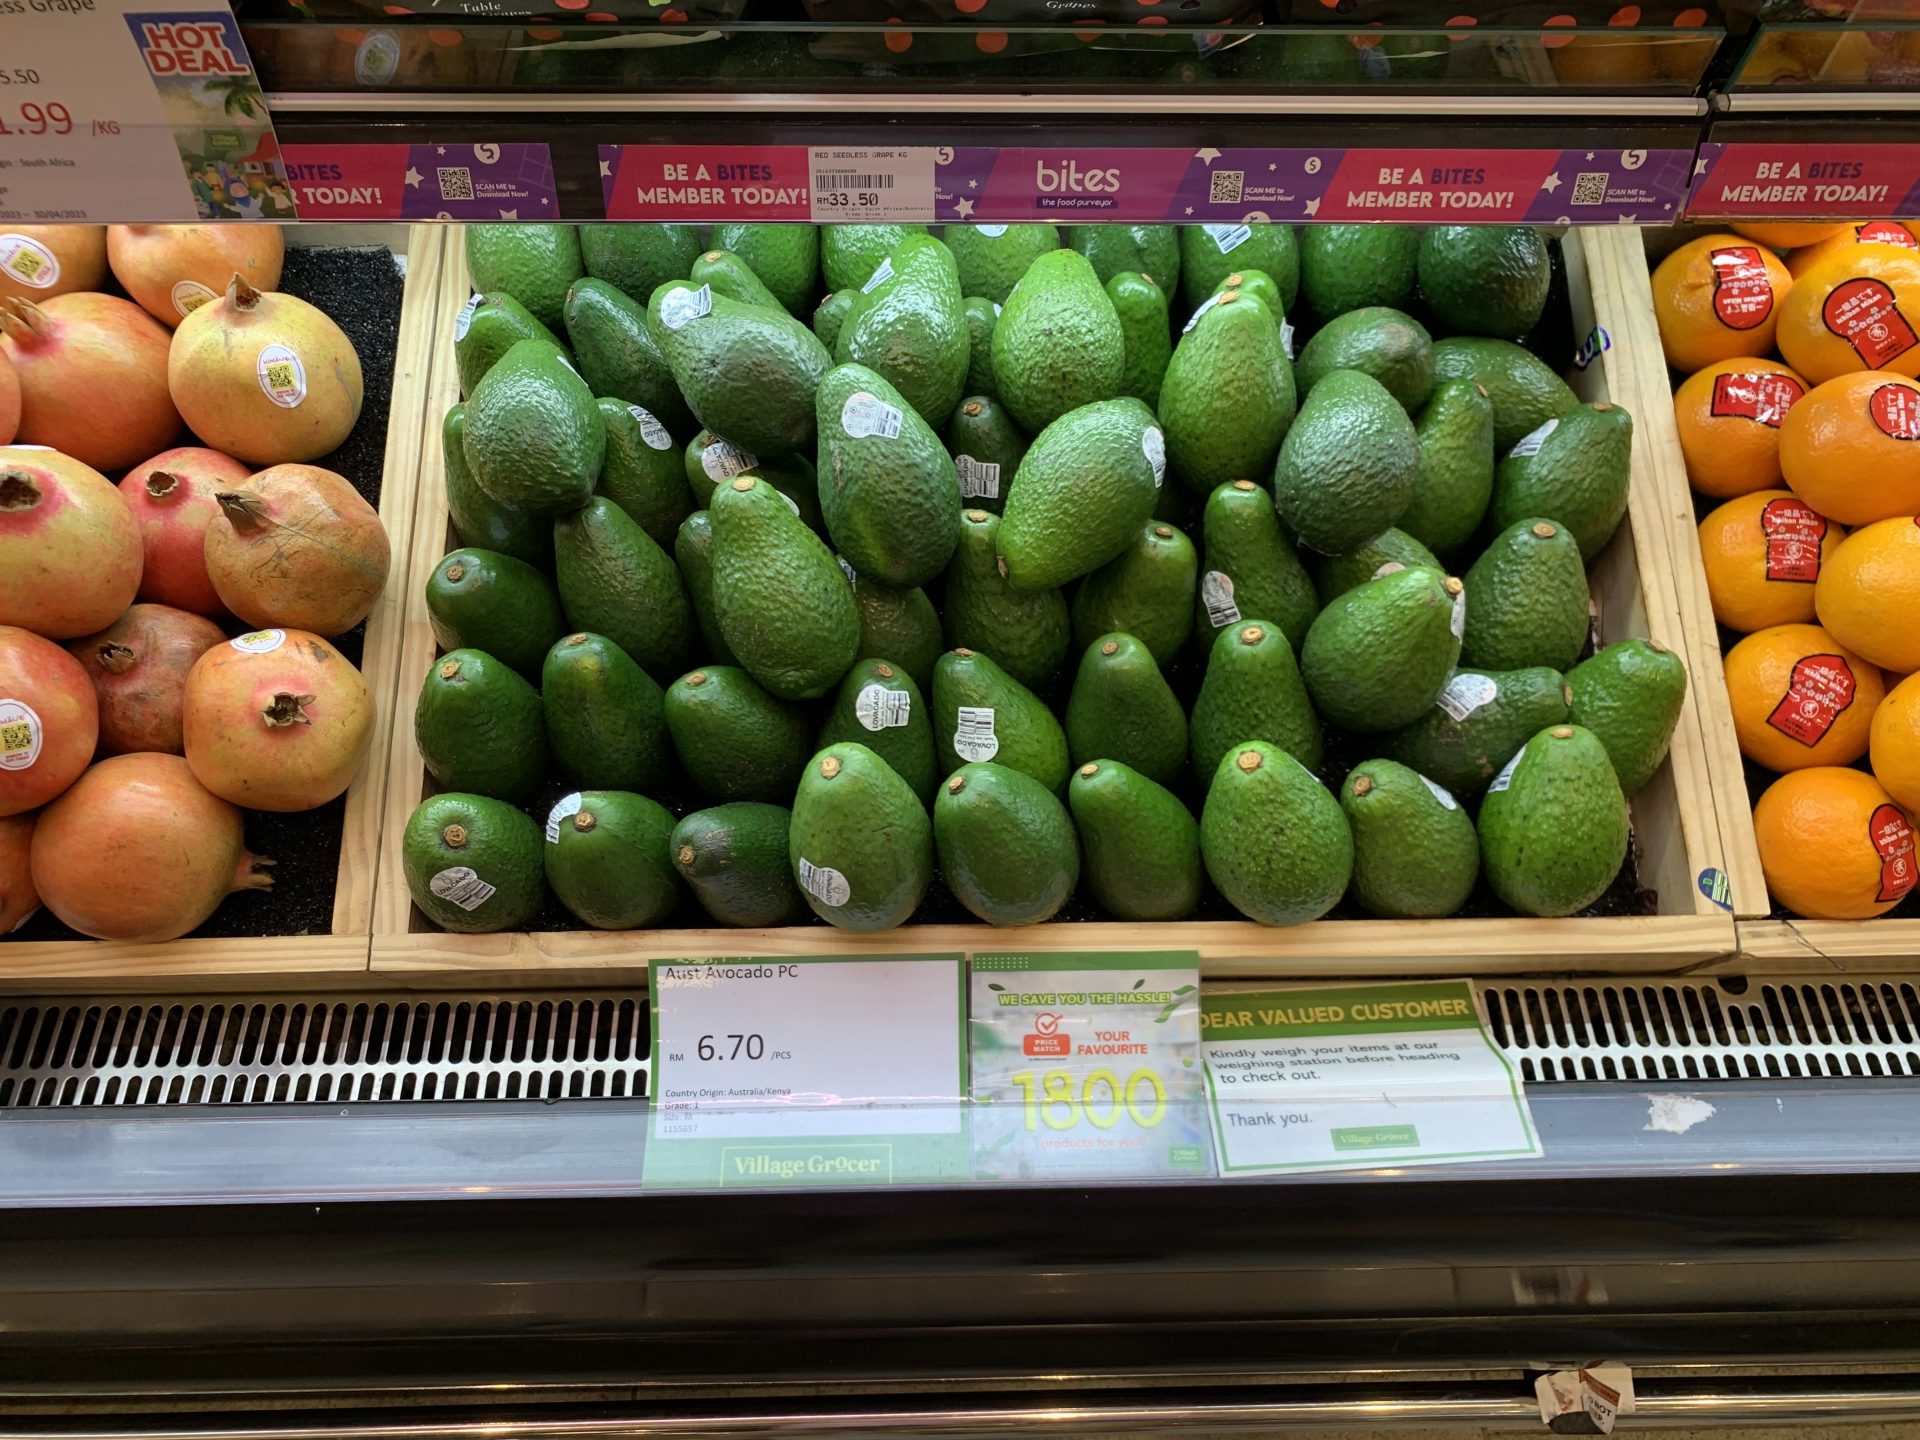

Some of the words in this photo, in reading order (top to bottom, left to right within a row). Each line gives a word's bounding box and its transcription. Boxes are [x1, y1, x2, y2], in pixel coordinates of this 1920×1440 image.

[28, 0, 96, 14] Grape
[460, 2, 501, 13] Table
[1046, 1, 1098, 9] Grapes
[145, 25, 223, 49] HOT
[147, 50, 247, 73] DEAL
[0, 68, 40, 85] 5.50
[92, 119, 121, 137] /KG
[20, 158, 47, 168] South
[49, 158, 77, 168] Africa
[832, 151, 868, 159] SEEDLESS
[872, 151, 894, 159] GRAPE
[288, 164, 343, 181] BITES
[663, 163, 689, 181] BE
[695, 163, 711, 181] A
[717, 164, 773, 181] BITES
[1036, 159, 1121, 192] bites
[1378, 167, 1406, 184] BE
[1408, 167, 1424, 184] A
[1431, 167, 1486, 185] BITES
[1756, 162, 1784, 179] BE
[1785, 162, 1801, 179] A
[1807, 162, 1863, 179] BITES
[475, 183, 495, 191] SCAN
[476, 190, 511, 198] Download
[511, 190, 529, 198] Now!
[1607, 188, 1625, 196] SCAN
[1626, 188, 1638, 196] ME
[1720, 185, 1808, 202] MEMBER
[1813, 185, 1889, 202] TODAY!
[302, 187, 384, 205] TODAY!
[637, 187, 726, 205] MEMBER
[731, 187, 808, 206] TODAY!
[1042, 198, 1056, 207] the
[1057, 198, 1076, 208] food
[1077, 199, 1113, 208] purveyor
[1243, 194, 1275, 202] Download
[1276, 194, 1295, 202] Now!
[1346, 191, 1437, 208] MEMBER
[1439, 191, 1513, 208] TODAY!
[1635, 195, 1656, 203] Now!
[1836, 307, 1861, 324] Ichiban
[1860, 293, 1882, 309] Mikan
[1897, 392, 1905, 409] Mikan
[1899, 410, 1907, 431] Ichiban
[1798, 518, 1819, 527] Mikan
[1803, 667, 1828, 685] Ichiban
[872, 689, 880, 729] LOVACADO
[957, 739, 996, 750] LOVACADO
[1879, 834, 1899, 846] Ichiban
[665, 966, 701, 981] Aust
[705, 964, 774, 980] Avocado
[778, 964, 799, 979] PC
[998, 993, 1018, 1006] WE
[1021, 993, 1055, 1006] SAVE
[1059, 993, 1086, 1005] YOU
[1088, 993, 1115, 1005] THE
[1117, 991, 1172, 1004] HASSLE!
[1201, 1009, 1254, 1029] DEAR
[1258, 1005, 1345, 1026] VALUED
[1351, 998, 1469, 1022] CUSTOMER
[1094, 1031, 1130, 1042] YOUR
[669, 1052, 685, 1062] RM
[697, 1033, 765, 1062] 6.70
[771, 1049, 792, 1062] /PCS
[1077, 1044, 1148, 1056] FAVOURITE
[1209, 1048, 1256, 1060] Kindly
[1261, 1046, 1306, 1058] weigh
[1310, 1046, 1344, 1056] your
[1349, 1043, 1389, 1053] items
[1394, 1042, 1411, 1051] at
[1414, 1041, 1439, 1050] our
[1215, 1058, 1286, 1071] weighing
[1289, 1057, 1342, 1067] station
[1346, 1054, 1395, 1065] before
[1399, 1051, 1460, 1063] heading
[1220, 1072, 1237, 1084] to
[1242, 1070, 1287, 1083] check
[1292, 1070, 1321, 1081] out.
[665, 1089, 698, 1099] Country
[699, 1088, 726, 1098] Origin:
[728, 1086, 792, 1098] Australia/Kenya
[1012, 1067, 1167, 1132] 1800
[664, 1101, 692, 1111] Grade:
[663, 1113, 683, 1121] Size:
[685, 1112, 693, 1121] M
[1227, 1111, 1276, 1128] Thank
[1280, 1113, 1313, 1128] you.
[1040, 1137, 1093, 1149] products
[1097, 1136, 1115, 1148] for
[1117, 1137, 1143, 1149] you!
[1339, 1133, 1373, 1146] Village
[1375, 1130, 1410, 1143] Grocer
[733, 1156, 805, 1179] Village
[808, 1154, 880, 1174] Grocer
